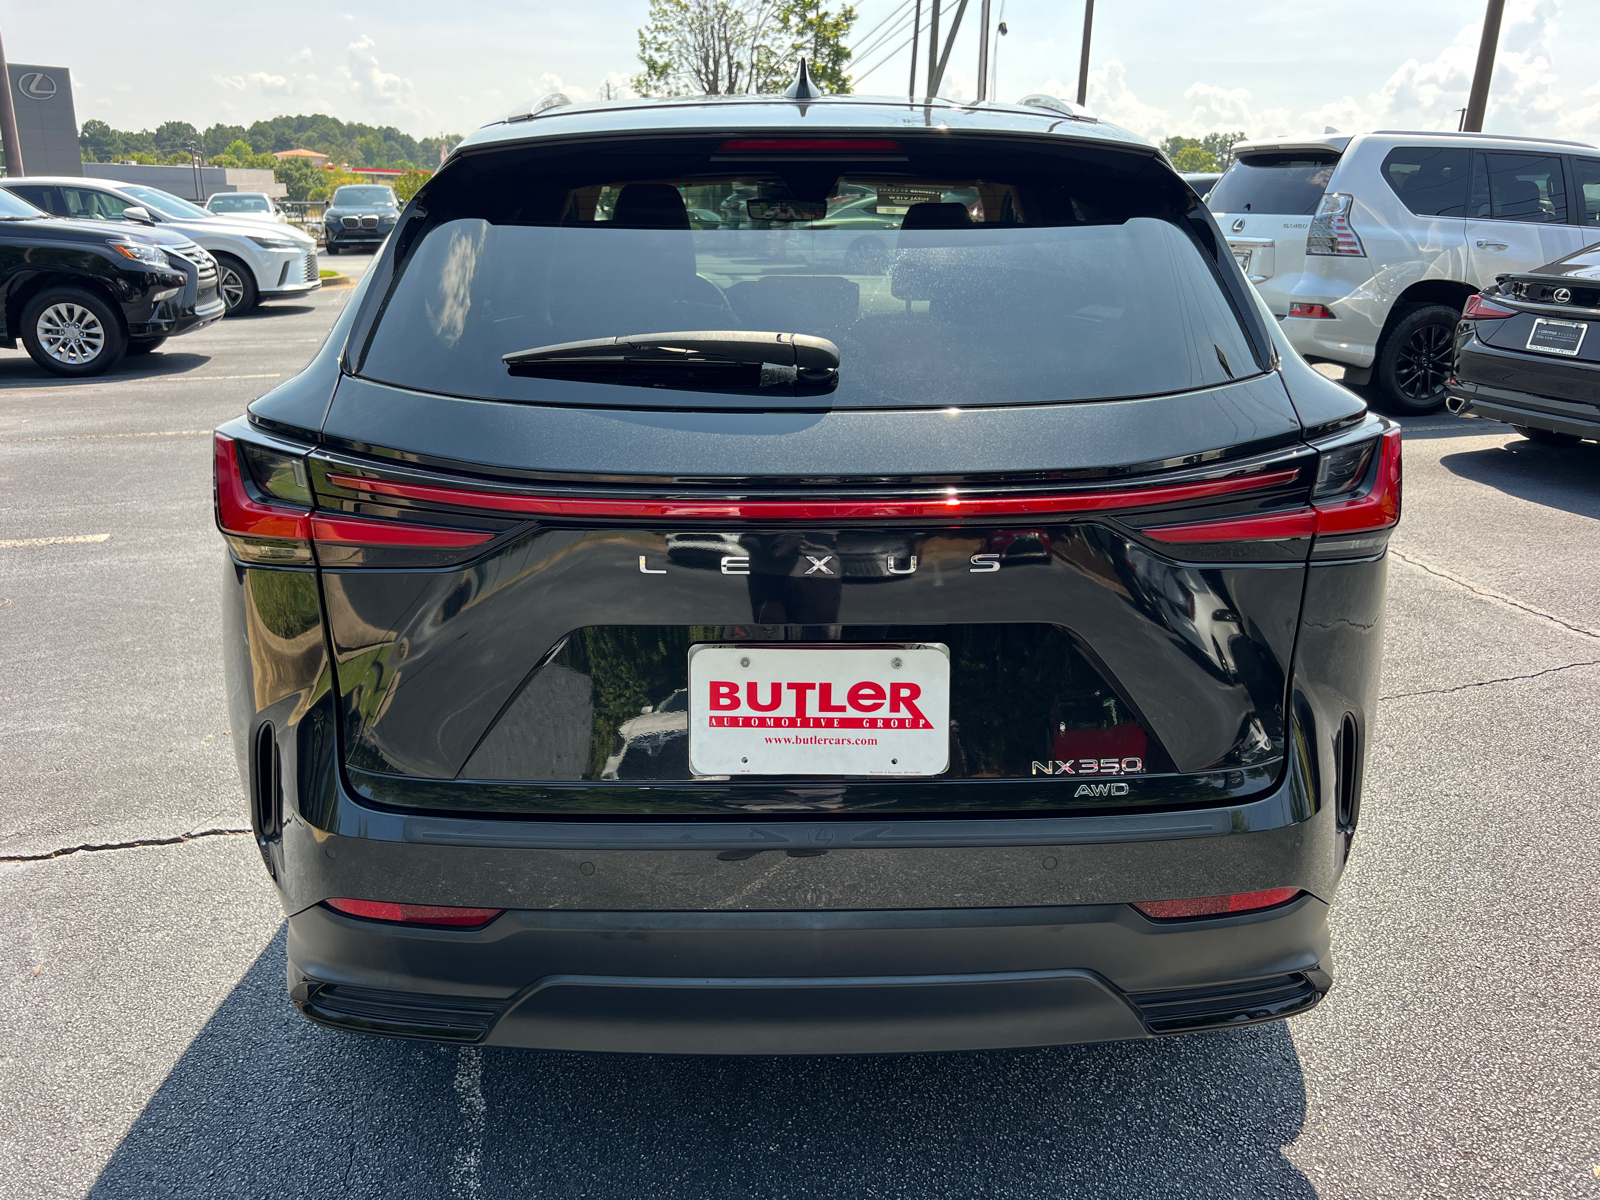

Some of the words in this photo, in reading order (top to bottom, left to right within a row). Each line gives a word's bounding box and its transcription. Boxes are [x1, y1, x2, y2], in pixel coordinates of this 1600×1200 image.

[638, 553, 1001, 575] LEXUS
[709, 716, 841, 728] AUTOMOTIVE
[862, 718, 927, 729] GROUP
[764, 735, 879, 746] www.butlercars.com
[1031, 757, 1143, 775] NX350
[1073, 782, 1130, 798] AWD
